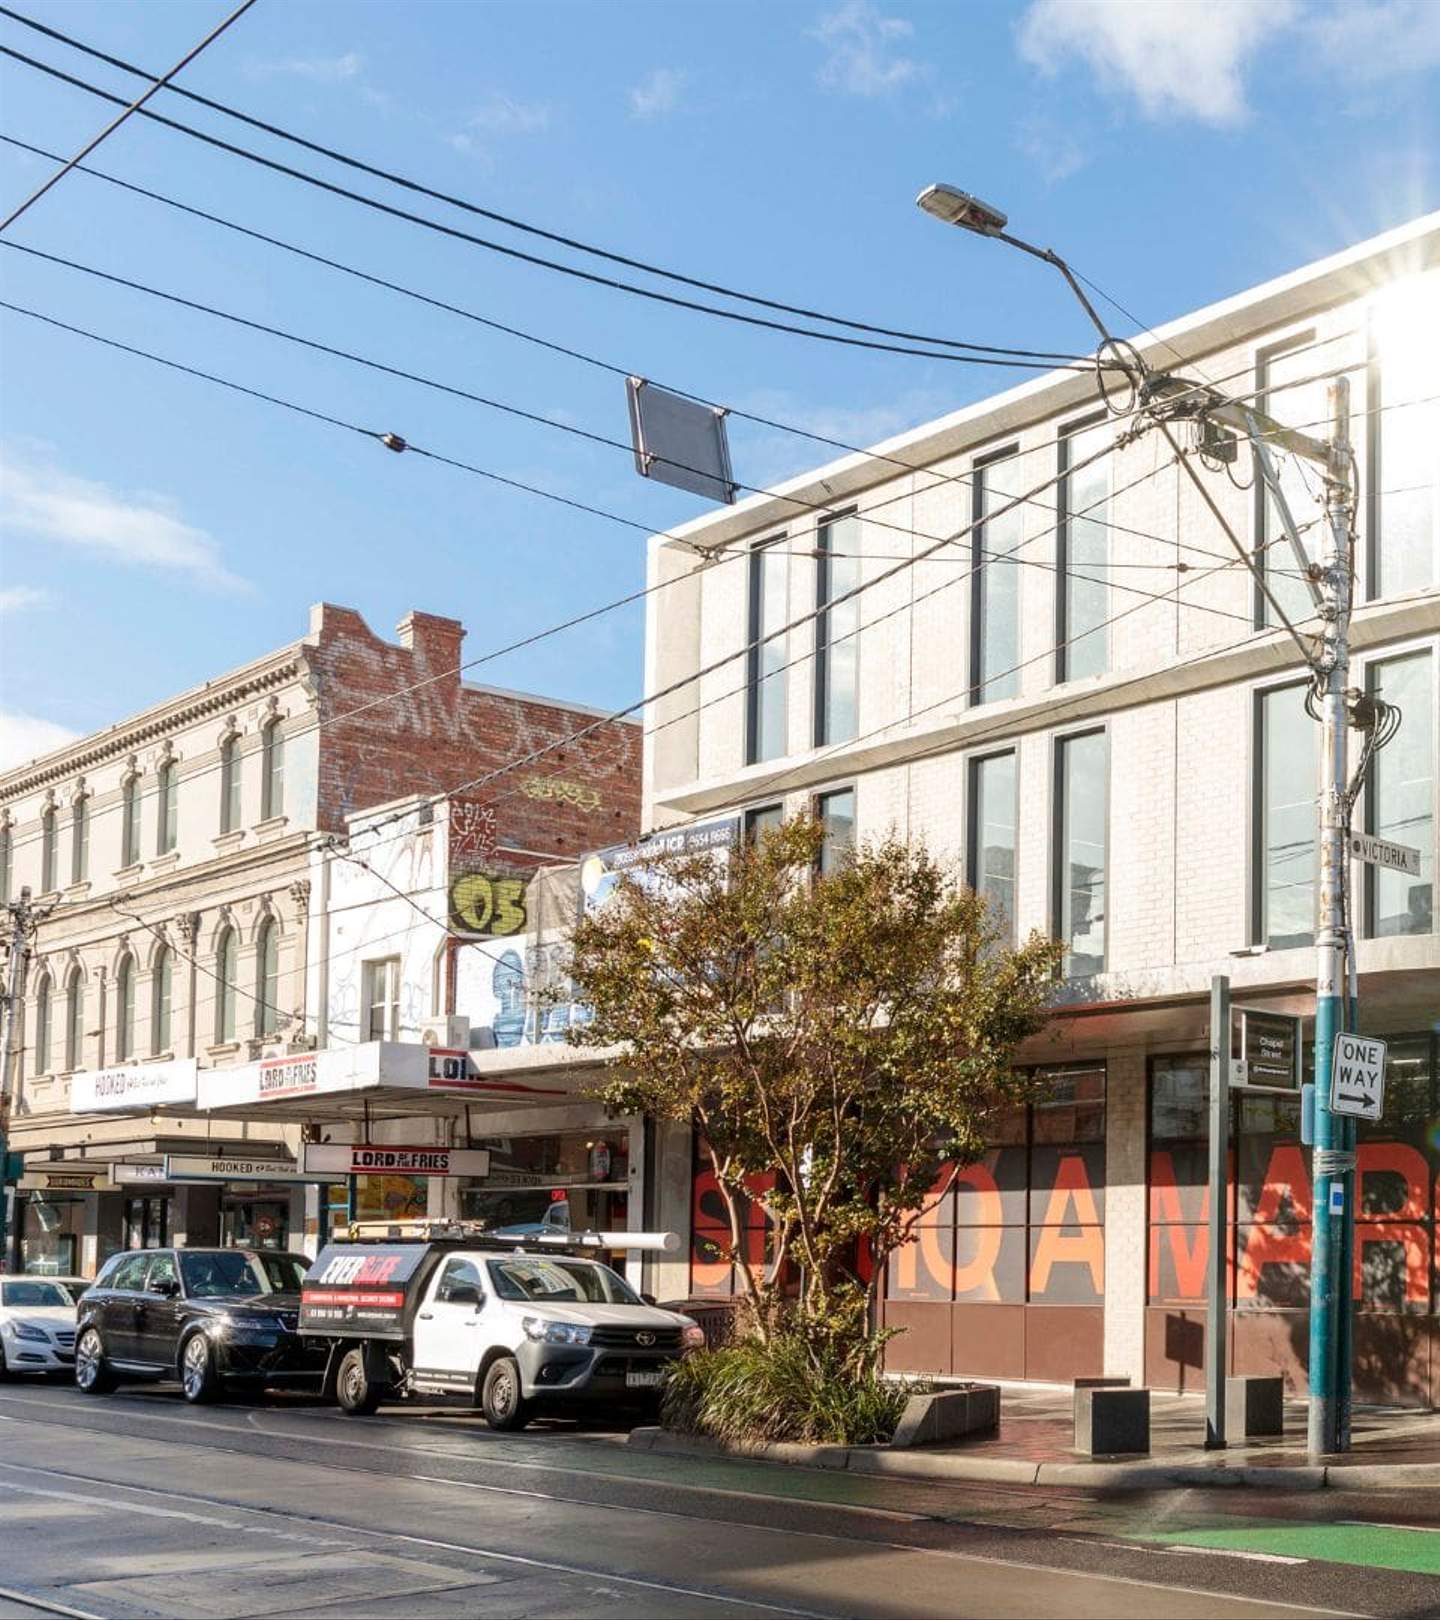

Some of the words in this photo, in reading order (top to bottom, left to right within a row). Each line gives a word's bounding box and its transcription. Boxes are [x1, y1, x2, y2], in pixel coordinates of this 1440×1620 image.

[1362, 840, 1407, 868] VICTORIA
[1343, 1043, 1378, 1066] ONE
[95, 1072, 126, 1098] HOOKED
[259, 1069, 284, 1091] LORD
[293, 1062, 317, 1086] FRIES
[1340, 1065, 1378, 1088] WAY
[211, 1161, 253, 1174] HOOKED
[352, 1151, 396, 1167] LORD
[411, 1153, 450, 1169] FRIES
